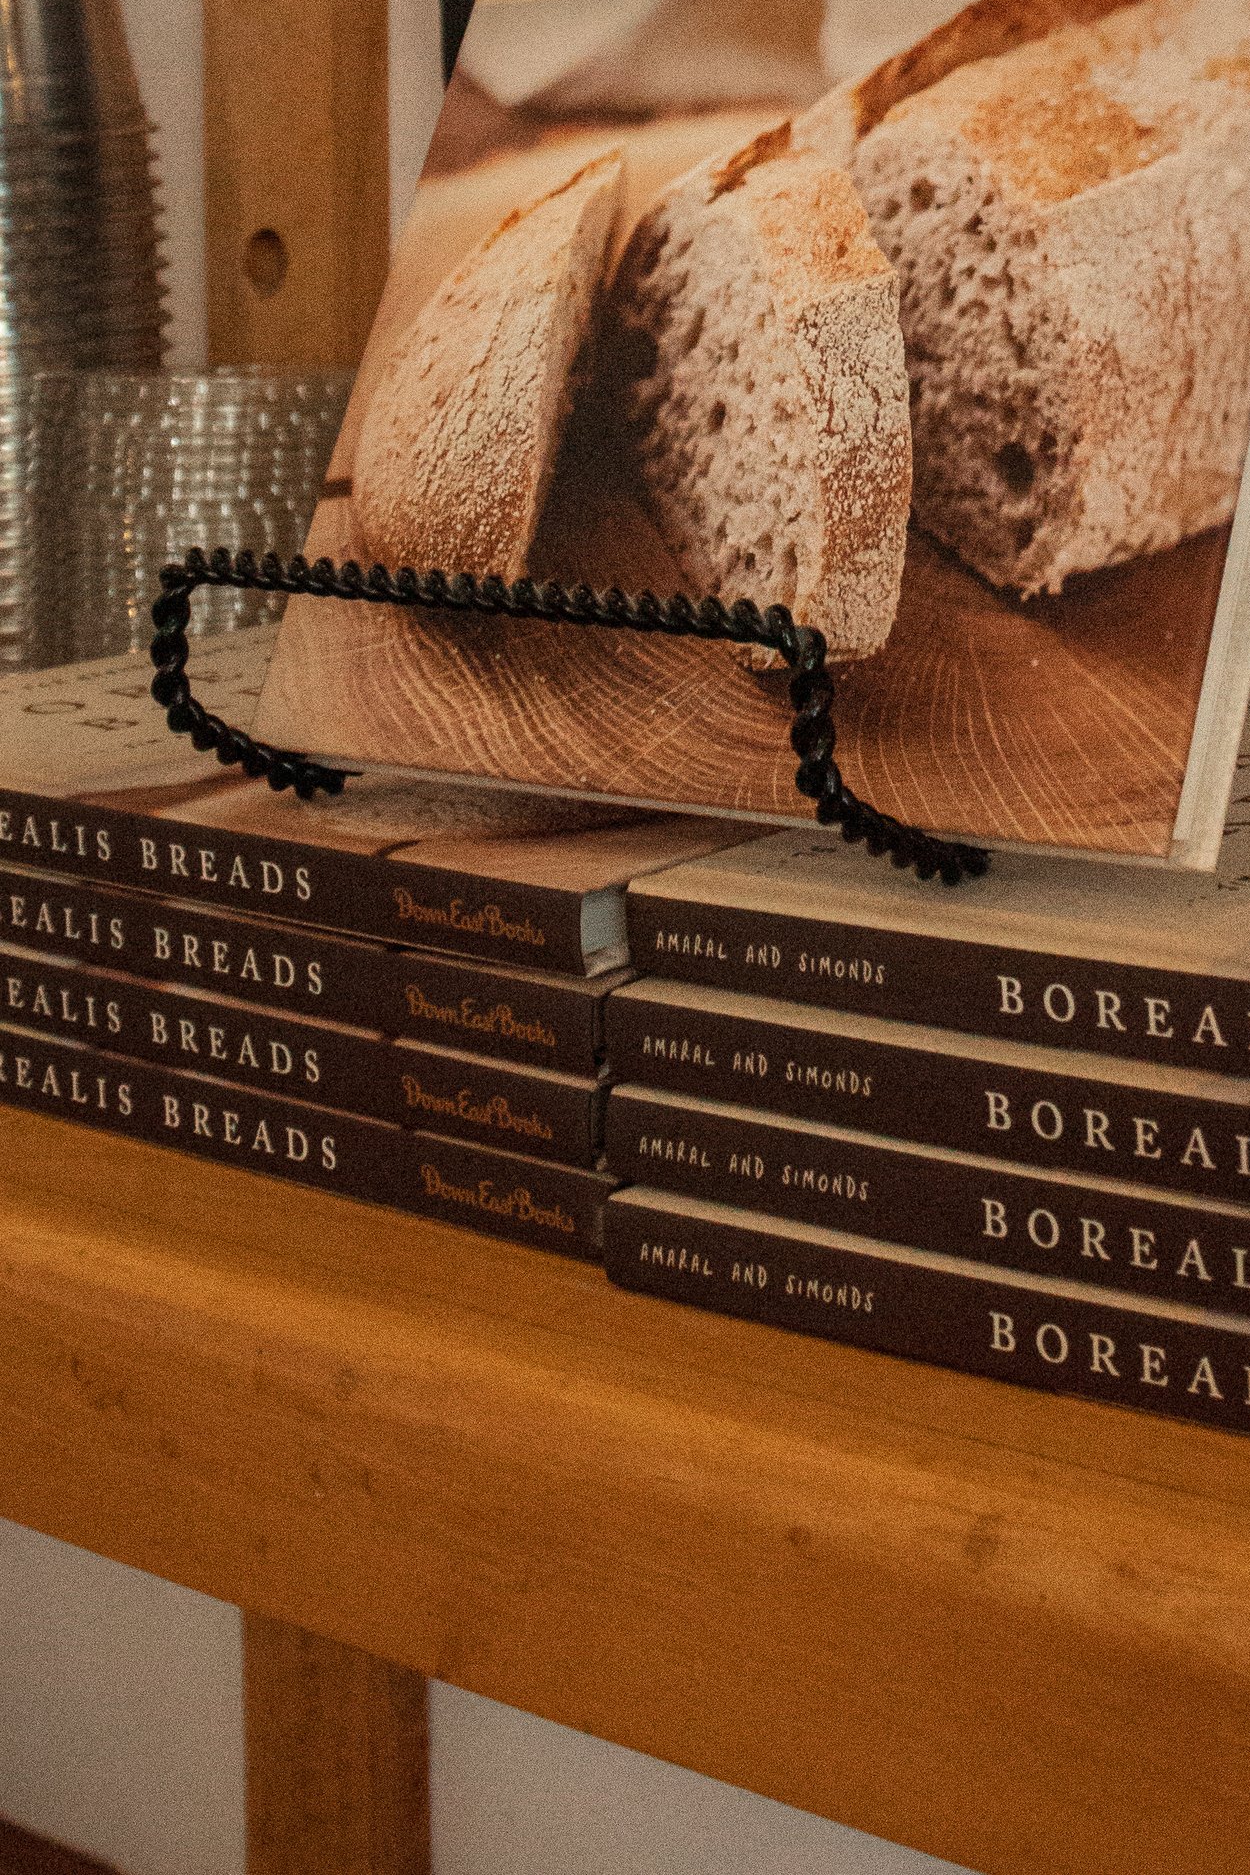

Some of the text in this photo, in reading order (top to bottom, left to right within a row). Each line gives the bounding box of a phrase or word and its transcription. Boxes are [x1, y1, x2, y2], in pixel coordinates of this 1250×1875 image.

[139, 838, 311, 900] BREADS
[153, 927, 322, 995] BREADS
[656, 930, 885, 985] AMARAL AND SIMONDS
[150, 1012, 320, 1082] BREADS
[643, 1035, 872, 1097] AMARAL AND SIMONDS
[162, 1095, 336, 1170] BREADS
[639, 1136, 868, 1201] AMARAL AND SIMONDS
[640, 1243, 874, 1312] AMARAL AND SIMONDS
